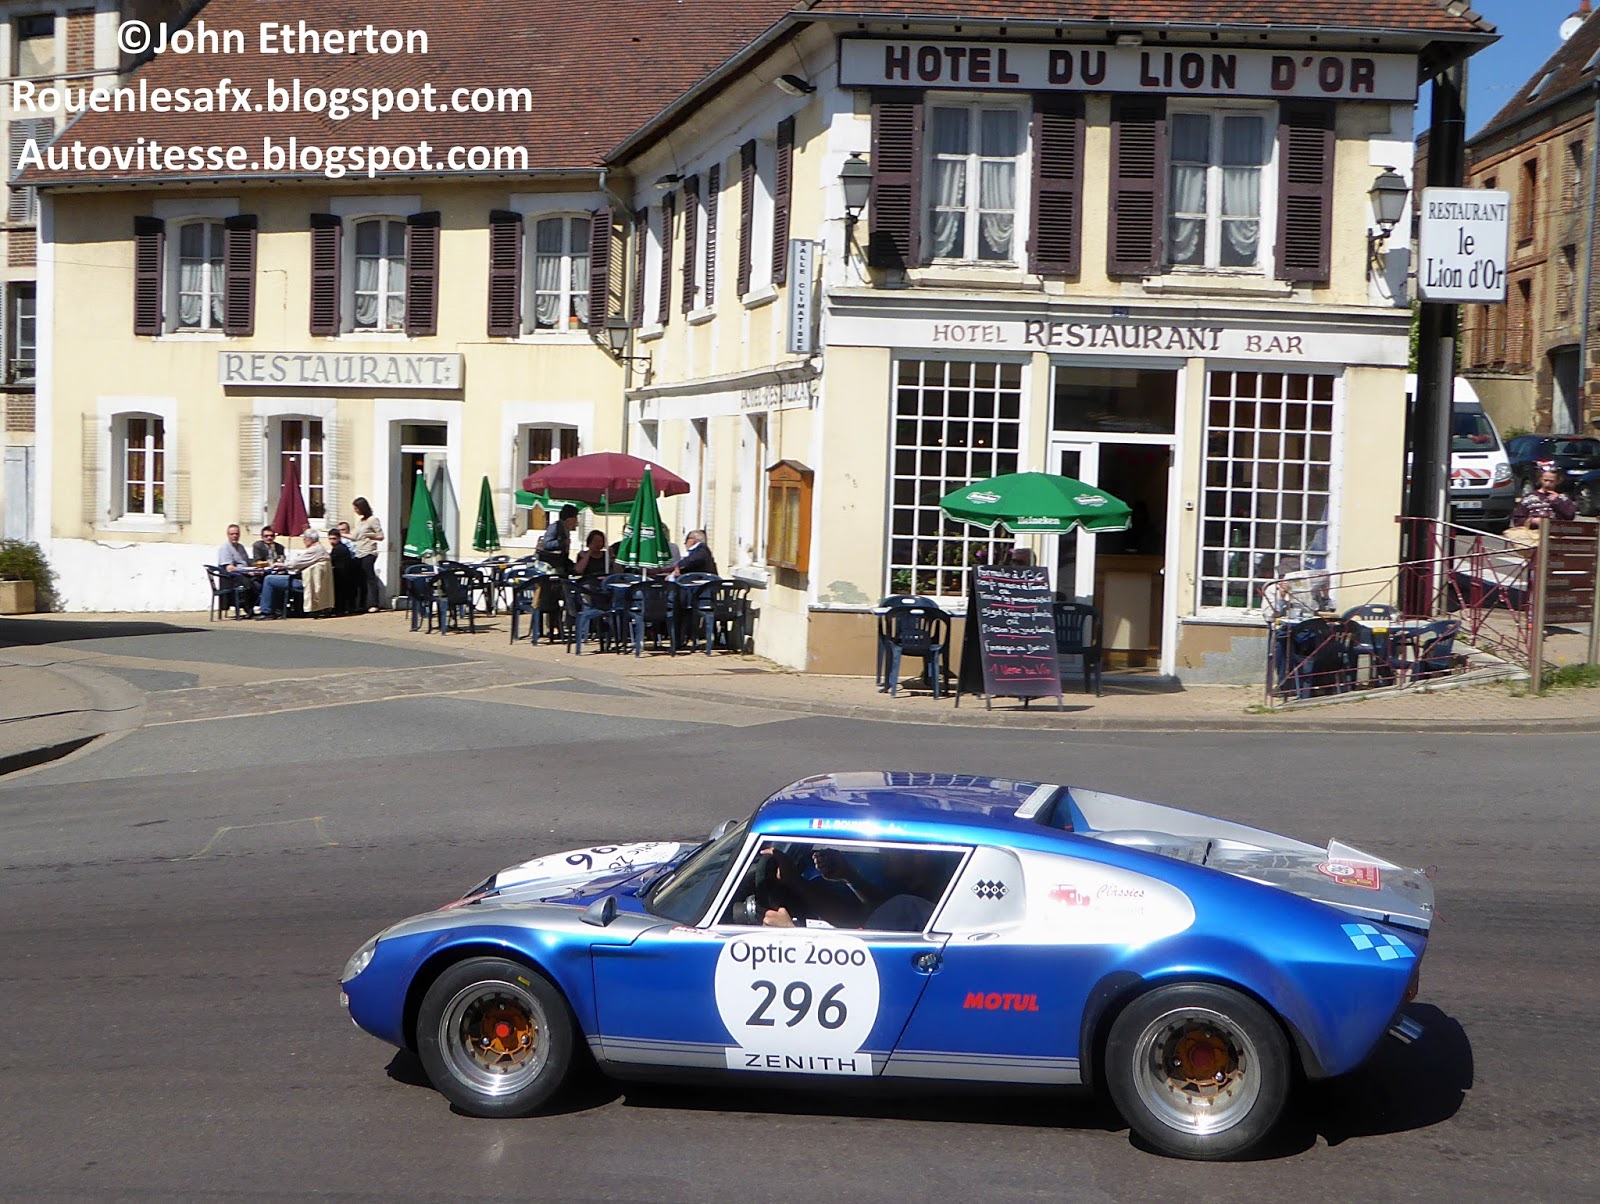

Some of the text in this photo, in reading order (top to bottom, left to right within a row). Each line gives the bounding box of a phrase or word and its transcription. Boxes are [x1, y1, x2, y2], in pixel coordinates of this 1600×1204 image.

[884, 45, 1375, 93] HOTEL DU LION D'OR
[1428, 202, 1506, 221] RESTAURANT
[1457, 226, 1475, 255] le
[799, 241, 807, 274] SALLE
[1426, 258, 1503, 290] Lion d'Or
[932, 320, 1304, 355] HOTEL RESTAURANT BAR
[225, 353, 446, 385] RESTAURANT
[730, 940, 866, 970] Optic 2000
[746, 980, 847, 1030] 296
[963, 992, 1040, 1012] MOTUL
[745, 1053, 857, 1072] ZENITH
